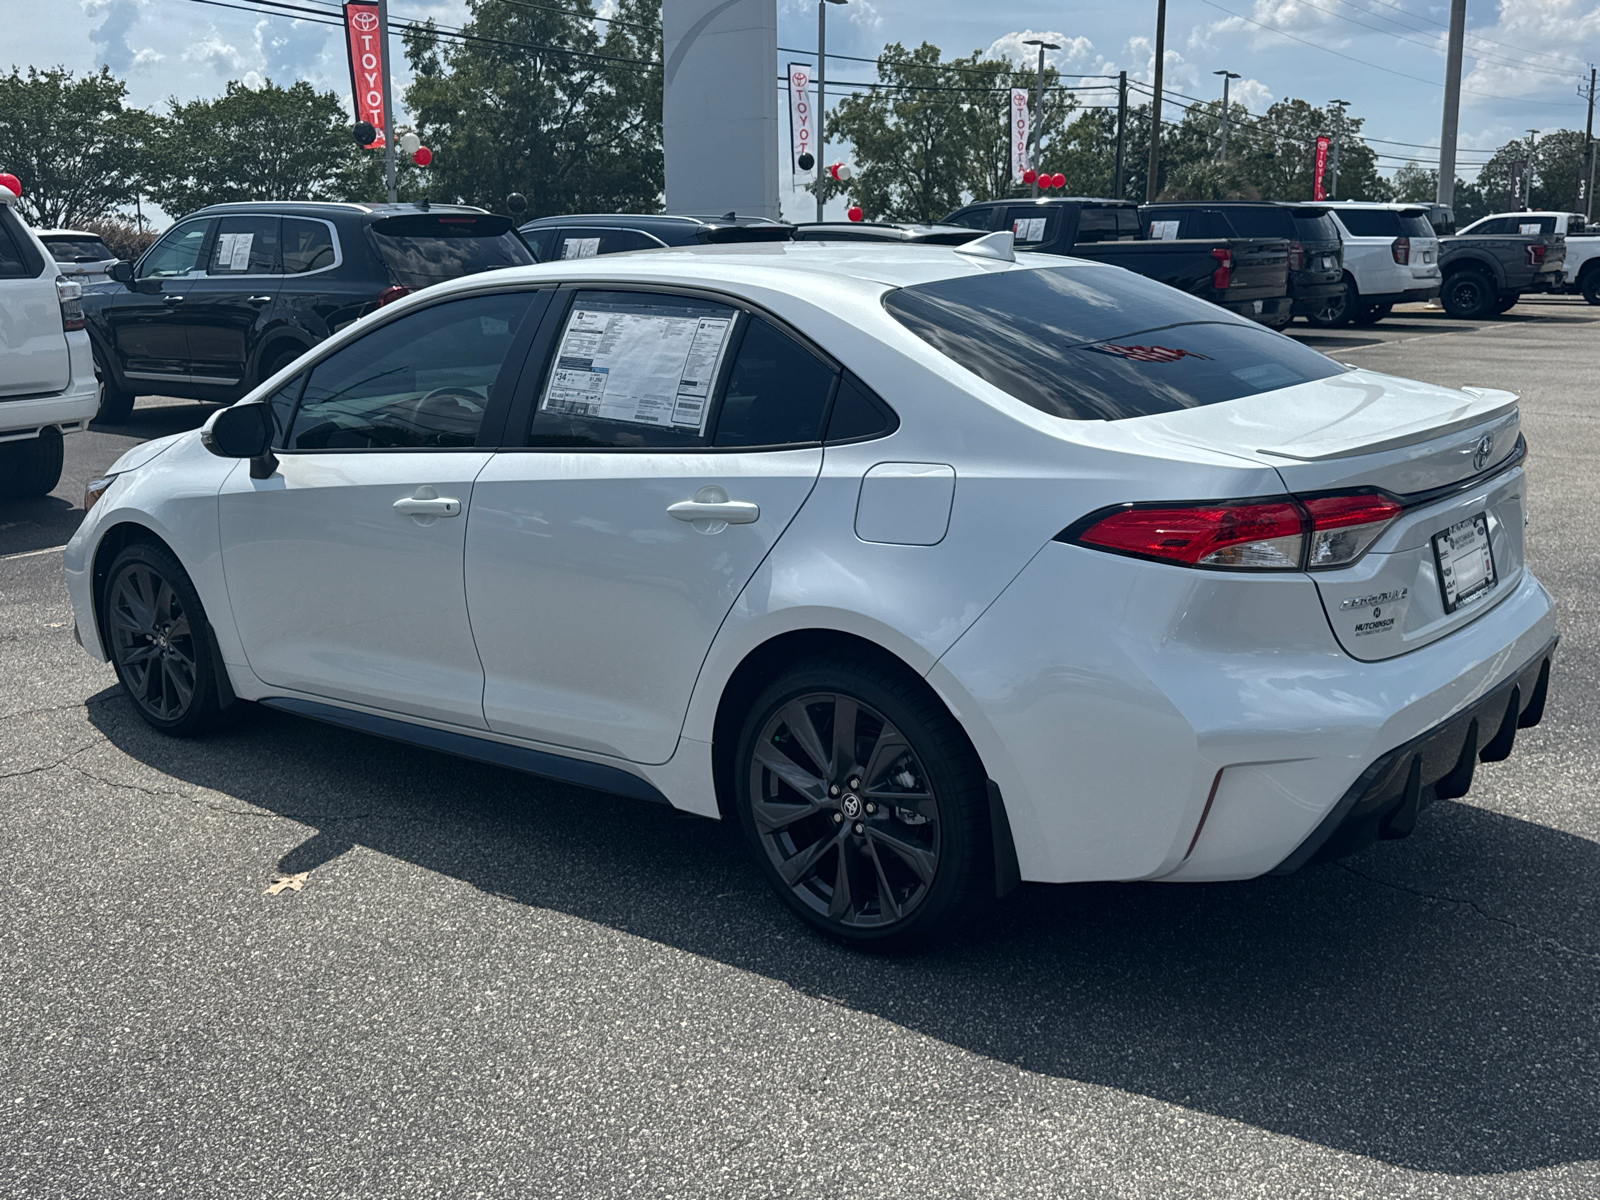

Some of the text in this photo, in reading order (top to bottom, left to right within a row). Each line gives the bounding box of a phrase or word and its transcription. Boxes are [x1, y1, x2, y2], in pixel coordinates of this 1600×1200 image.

[361, 35, 385, 141] TOYOTA
[796, 89, 809, 153] TOYOT
[1016, 108, 1026, 173] TOYOTA
[1354, 617, 1395, 632] HUTCHINSON
